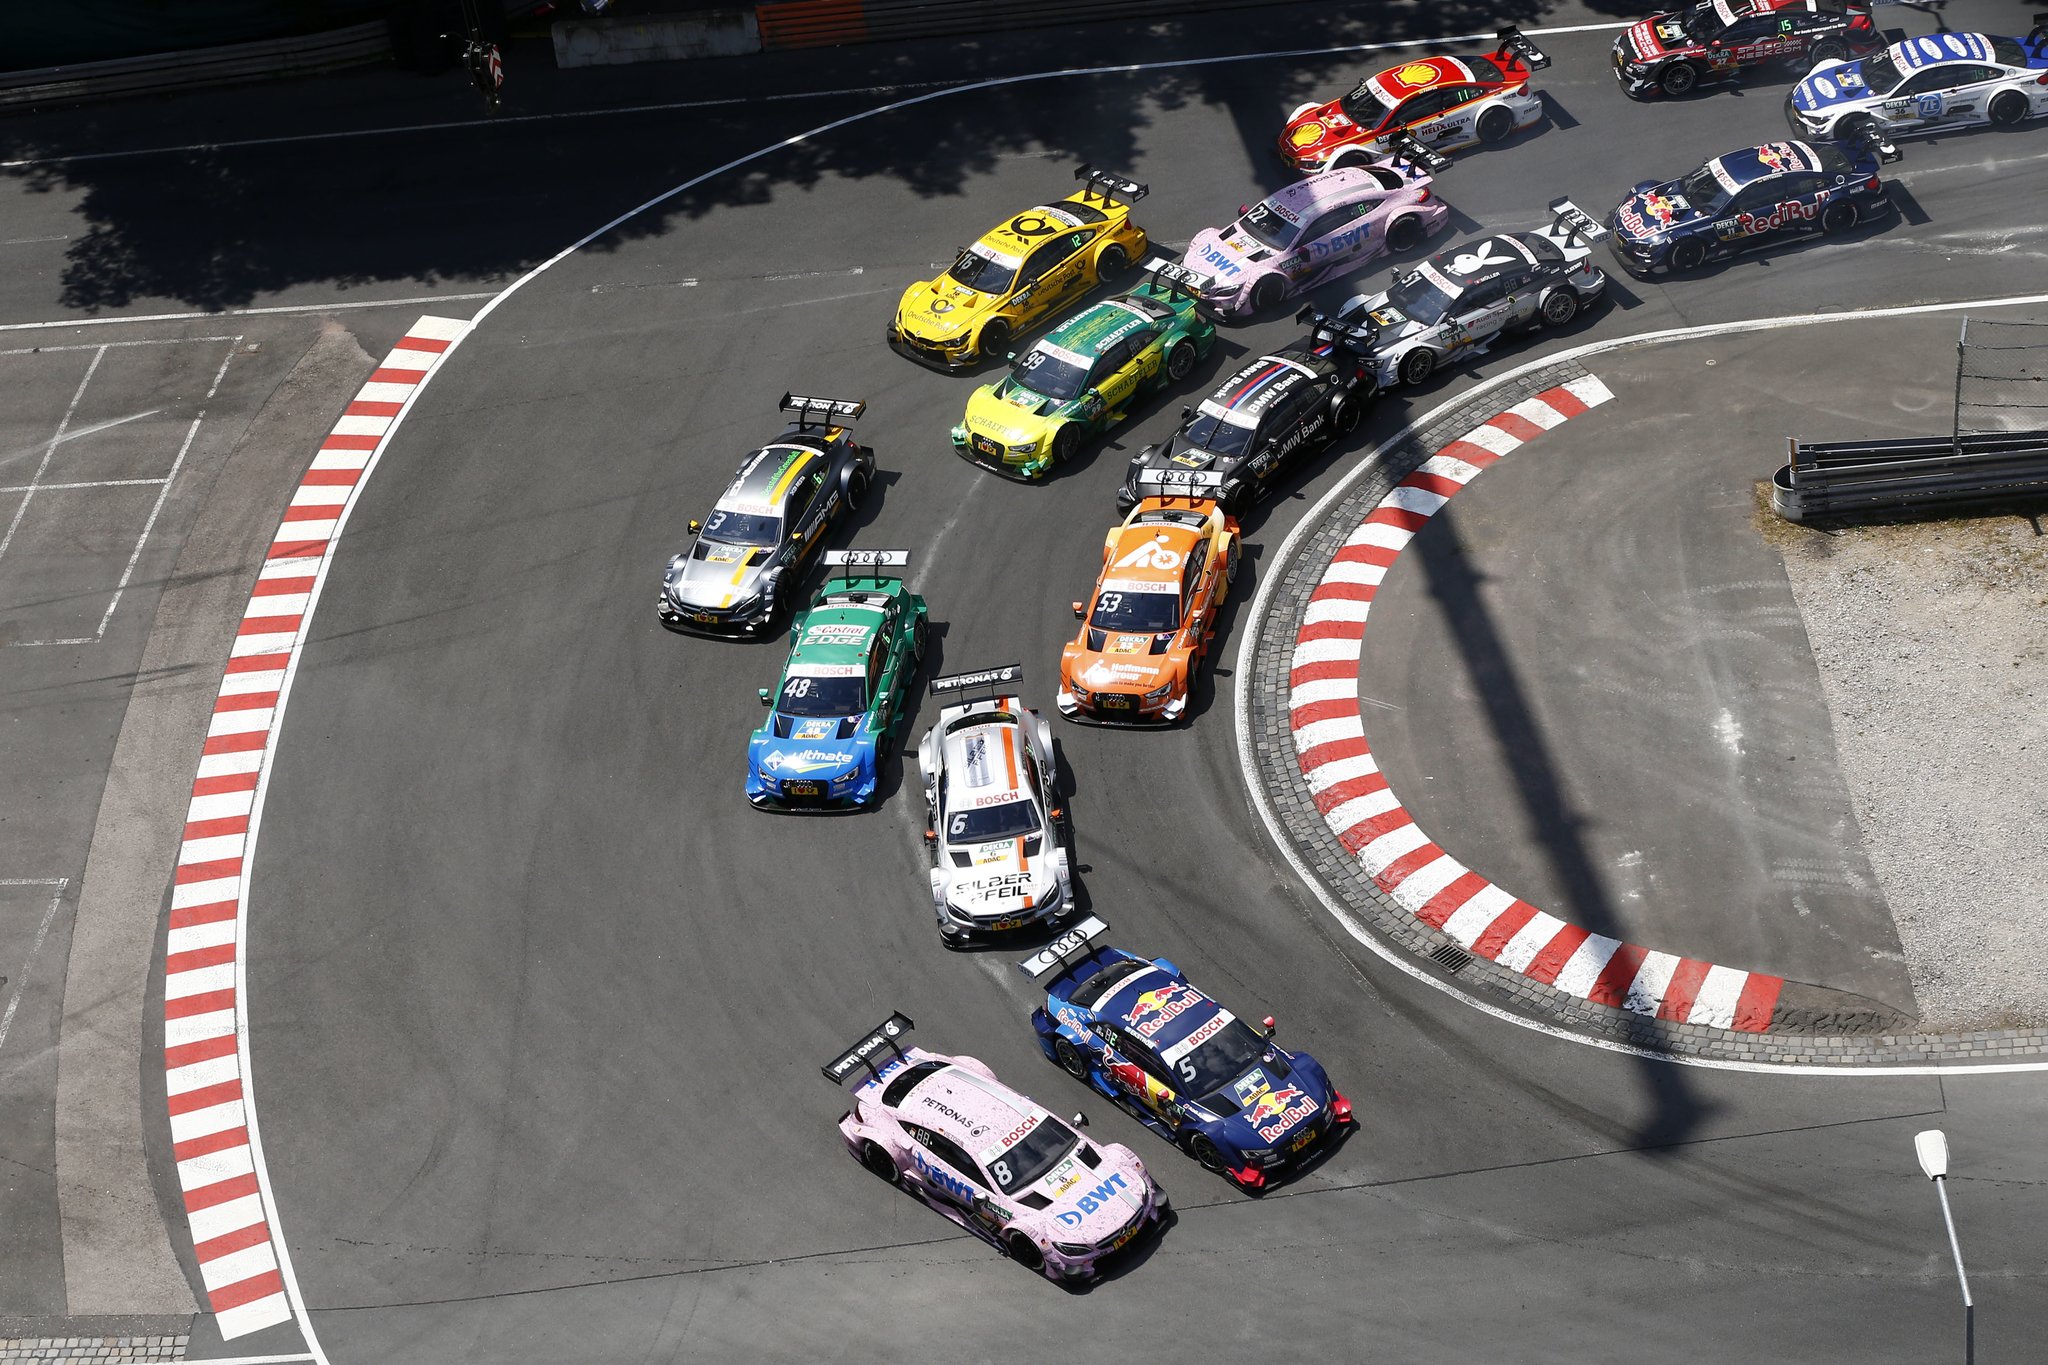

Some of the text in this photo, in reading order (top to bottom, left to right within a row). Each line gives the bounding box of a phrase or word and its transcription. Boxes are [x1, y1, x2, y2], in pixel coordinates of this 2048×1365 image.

[1780, 19, 1792, 32] 15
[1737, 41, 1782, 55] SPEED
[1737, 45, 1802, 61] WEEK.COM
[1885, 100, 1908, 109] DEKRA
[1895, 107, 1906, 115] 36
[1922, 100, 1938, 112] ZF
[1421, 116, 1471, 136] HELIX ULTRA
[1715, 169, 1735, 189] BOSCH
[1247, 205, 1269, 224] 22
[1274, 204, 1300, 224] BOSCH
[1716, 219, 1738, 229] DEKRA
[1071, 234, 1082, 249] 12
[1329, 222, 1371, 253] BWT
[958, 253, 978, 270] 16
[1205, 251, 1242, 278] BWT
[1401, 271, 1422, 288] 51
[1428, 270, 1453, 292] BOSCH
[1011, 291, 1032, 305] DEKRA
[1022, 351, 1047, 370] 99
[1052, 348, 1083, 364] BOSCH
[1248, 372, 1303, 414] BMW Bank
[1252, 452, 1271, 470] DEKRA
[736, 503, 774, 515] BOSCH
[708, 511, 727, 531] 3
[1127, 582, 1167, 592] BOSCH
[1096, 592, 1123, 613] 53
[820, 625, 866, 636] Castrol
[1119, 635, 1147, 643] DEKRA
[802, 635, 867, 647] EDGE
[813, 666, 854, 676] BOSCH
[1111, 663, 1160, 675] Hoffmann
[783, 678, 812, 699] 48
[937, 672, 998, 690] PETRONAS
[806, 720, 831, 728] DEKRA
[976, 791, 1019, 807] BOSCH
[950, 813, 969, 835] 6
[982, 842, 1011, 853] DEKRA
[1188, 1017, 1224, 1046] BOSCH
[1178, 1056, 1197, 1083] 5
[919, 1096, 974, 1129] PETRONAS
[1001, 1115, 1039, 1148] BOSCH
[993, 1160, 1013, 1187] 8
[1047, 1162, 1073, 1185] DEKRA
[1075, 1172, 1129, 1216] BWT
